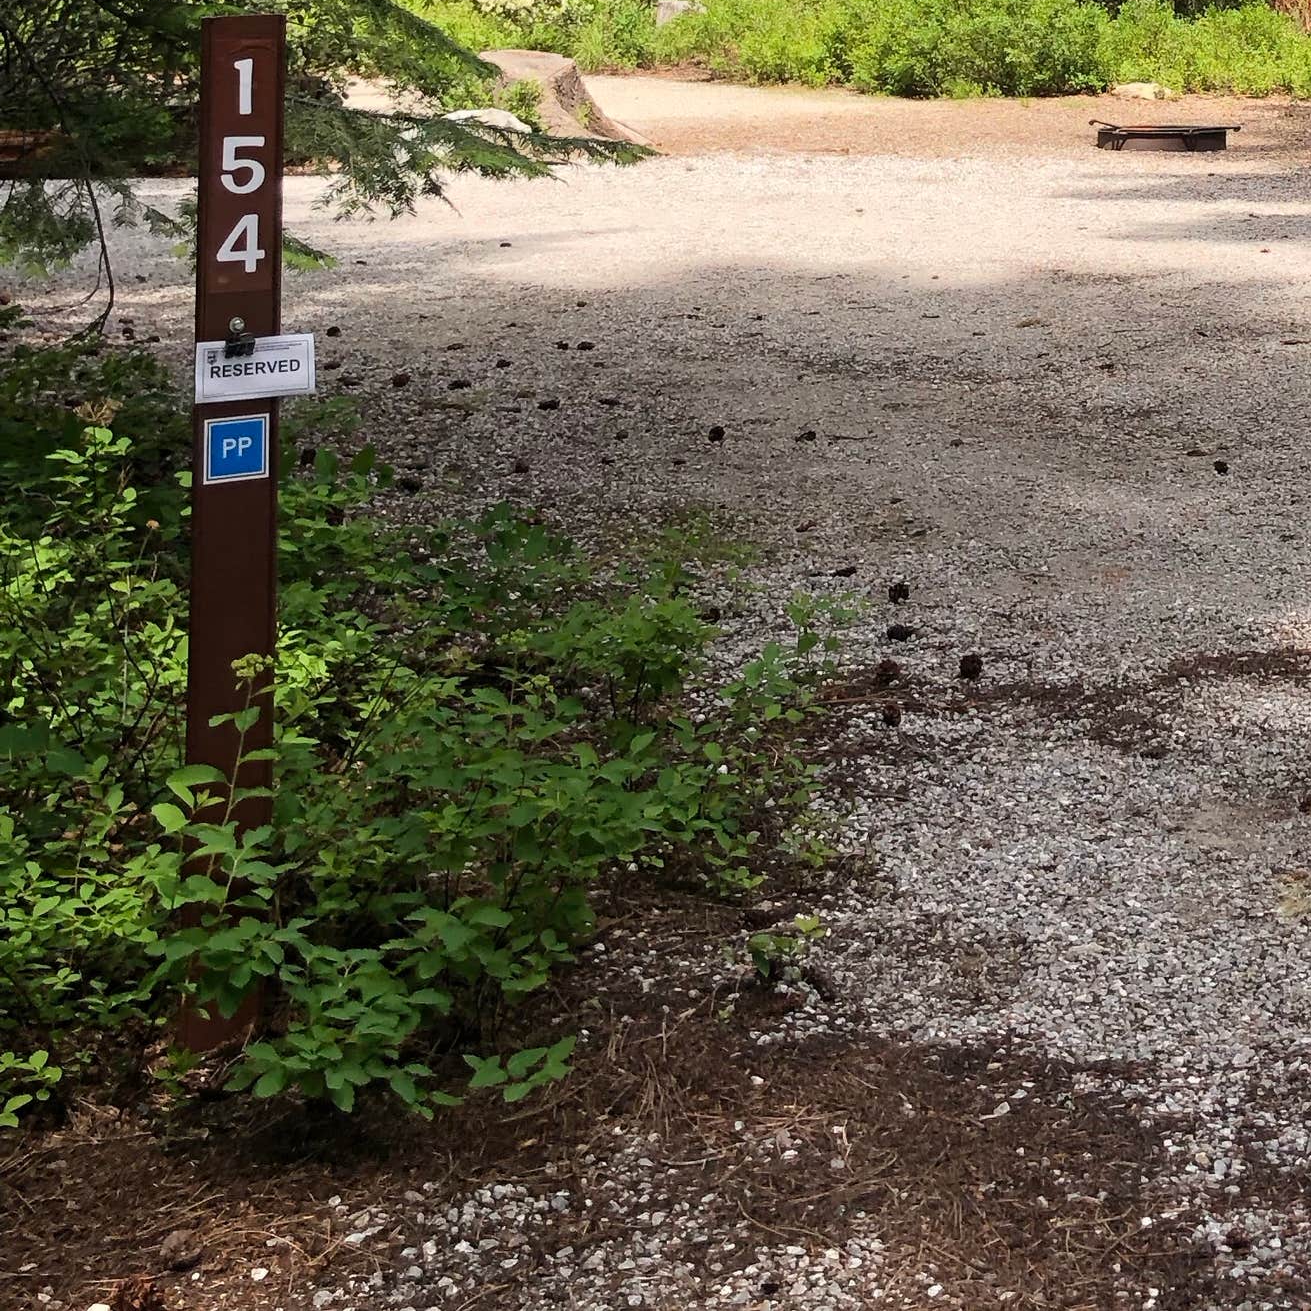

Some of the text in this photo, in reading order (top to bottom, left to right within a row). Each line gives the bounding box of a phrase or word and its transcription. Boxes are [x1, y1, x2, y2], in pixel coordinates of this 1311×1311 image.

[216, 58, 265, 273] 154
[210, 359, 301, 379] RESERVED
[222, 436, 253, 459] PP
